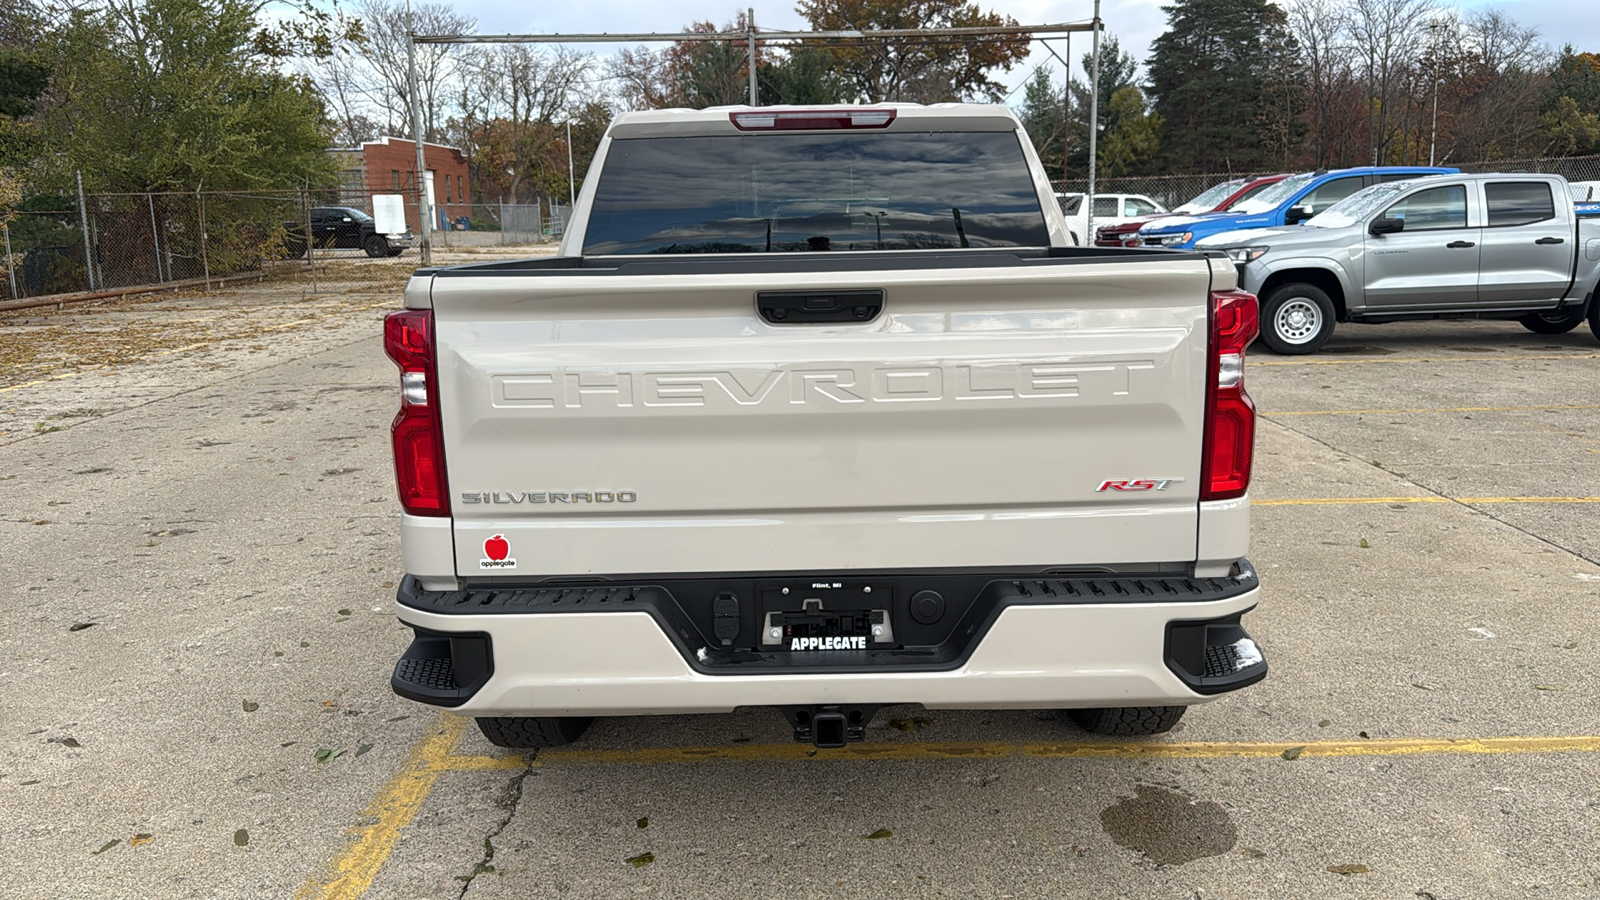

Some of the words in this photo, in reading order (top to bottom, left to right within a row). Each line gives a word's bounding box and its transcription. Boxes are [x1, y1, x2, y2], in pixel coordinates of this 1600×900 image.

[490, 360, 1155, 409] CHEVROLET
[1095, 477, 1185, 492] RST
[461, 491, 637, 503] SILVERADO
[791, 637, 866, 650] APPLEGATE
